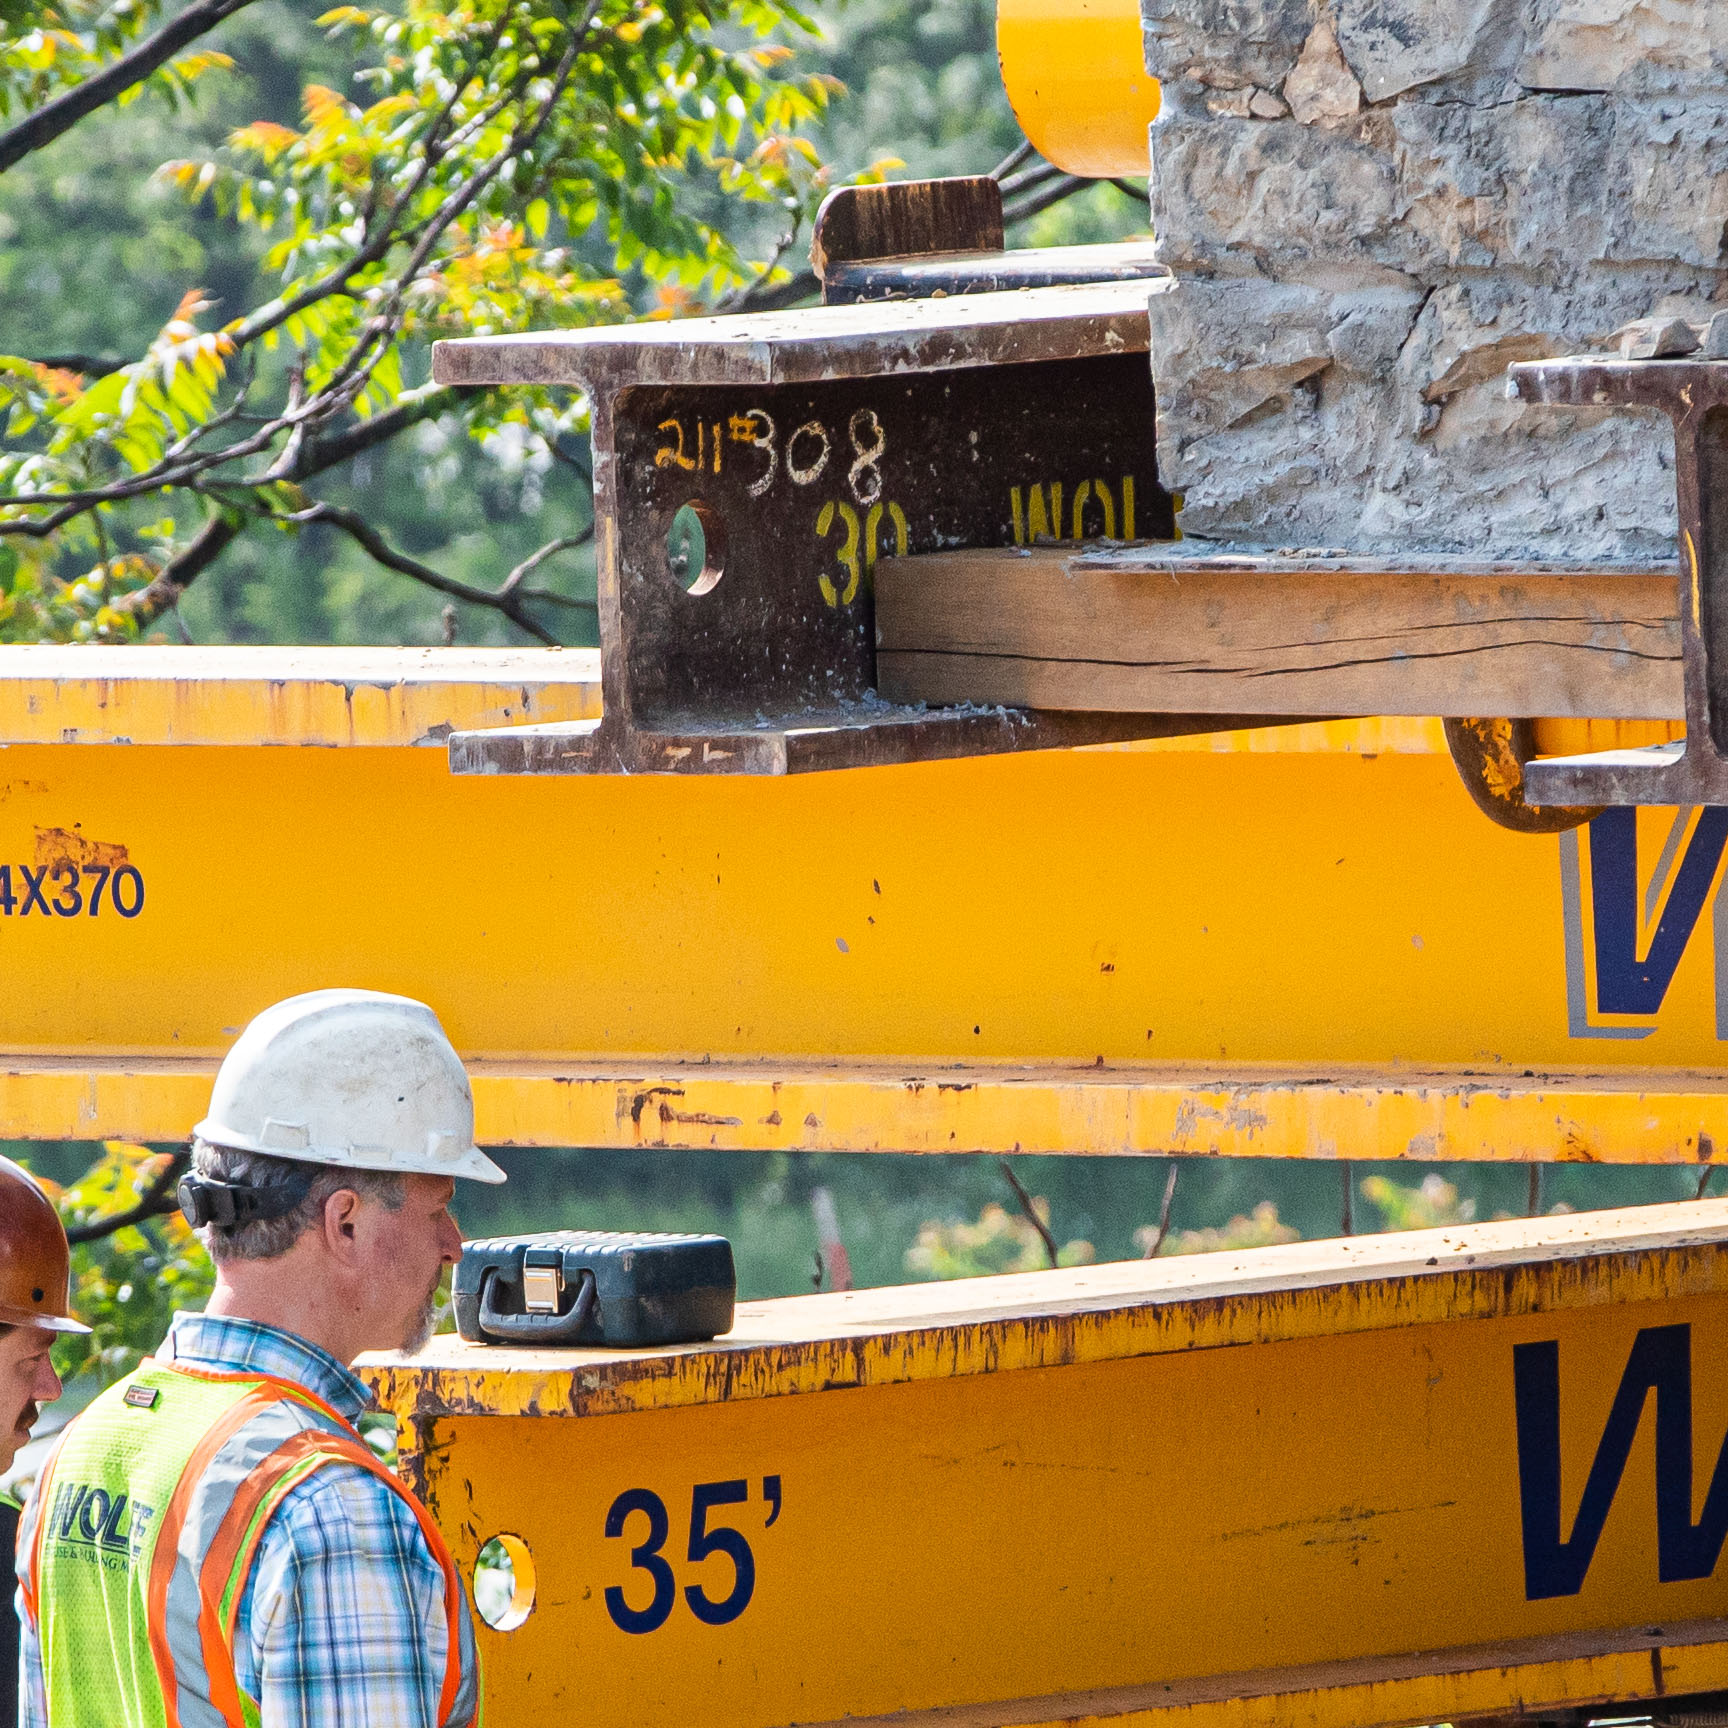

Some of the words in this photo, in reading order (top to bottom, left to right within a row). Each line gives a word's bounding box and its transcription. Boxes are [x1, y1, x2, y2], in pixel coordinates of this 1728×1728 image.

[746, 408, 886, 504] 308
[816, 500, 909, 607] 30
[604, 1474, 783, 1635] 35'
